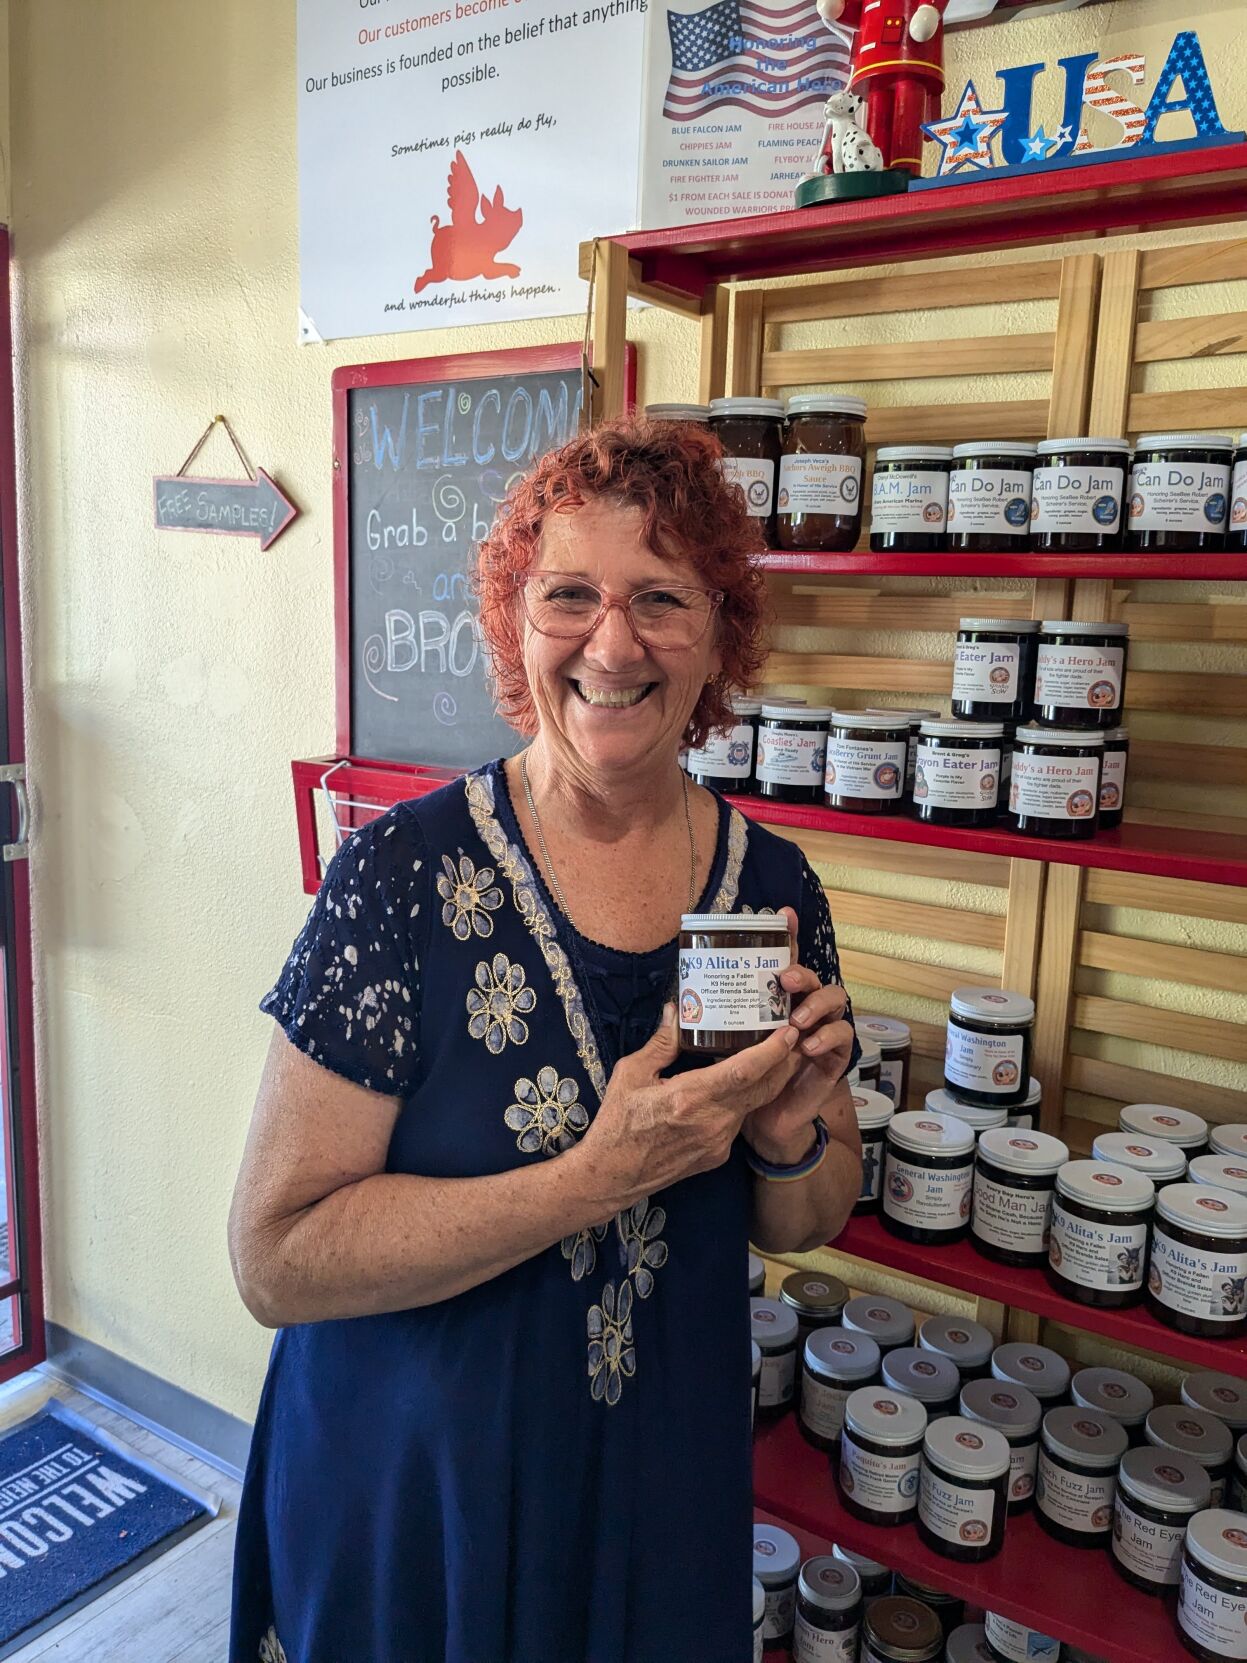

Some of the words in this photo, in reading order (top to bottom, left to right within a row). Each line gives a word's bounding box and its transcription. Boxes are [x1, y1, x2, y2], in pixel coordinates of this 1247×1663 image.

[358, 29, 381, 45] Our
[385, 10, 451, 38] customers
[305, 77, 328, 93] Our
[330, 65, 382, 88] business
[386, 59, 395, 73] is
[399, 45, 454, 70] founded
[458, 43, 474, 57] on
[478, 36, 500, 51] the
[504, 23, 547, 46] belief
[548, 13, 578, 34] that
[582, 0, 648, 25] anything
[729, 35, 816, 50] Honoring
[755, 59, 787, 72] the
[441, 63, 500, 92] possible.
[700, 79, 790, 96] American
[797, 77, 842, 91] Hero
[996, 31, 1227, 165] USA
[692, 125, 724, 133] FALCON
[725, 124, 741, 132] JAM
[768, 123, 785, 131] FIRE
[786, 122, 814, 130] HOUSE
[815, 121, 825, 130] JA
[391, 138, 450, 157] Sometimes
[453, 130, 476, 148] pigs
[480, 122, 513, 140] really
[517, 118, 532, 130] do
[535, 113, 557, 130] fly,
[680, 142, 713, 150] CHIPPIES
[758, 139, 794, 148] FLAMING
[663, 159, 700, 167] DRUNKEN
[702, 158, 729, 166] SAILOR
[731, 157, 748, 165] JAM
[774, 155, 804, 164] FLYBOY
[670, 175, 686, 183] FIRE
[688, 174, 723, 183] FIGHTER
[724, 174, 739, 182] JAM
[669, 193, 679, 201] $1
[681, 192, 706, 201] FROM
[708, 192, 729, 200] EACH
[731, 191, 751, 199] SALE
[754, 191, 761, 199] IS
[685, 206, 730, 215] WOUNDED
[732, 205, 778, 214] WARRIORS
[384, 301, 406, 313] and
[409, 293, 467, 311] wonderful
[469, 288, 506, 301] things
[510, 285, 561, 299] happen.
[808, 464, 837, 473] Aweigh
[839, 465, 856, 474] BBQ
[803, 475, 827, 483] Sauce
[951, 480, 966, 492] Can
[972, 478, 994, 492] Do
[998, 478, 1024, 496] Jam
[1035, 478, 1051, 491] Can
[1058, 475, 1081, 489] Do
[1086, 475, 1113, 493] Jam
[1137, 472, 1160, 486] Can
[1168, 471, 1194, 486] Do
[1198, 472, 1223, 490] Jam
[907, 481, 931, 497] Jam
[158, 489, 191, 523] FREE
[367, 508, 427, 550] Grab
[442, 521, 456, 543] a
[385, 609, 490, 676] BRO
[960, 651, 987, 661] Eater
[989, 652, 1014, 664] Jam
[1068, 657, 1094, 666] Hero
[1096, 658, 1116, 667] Jam
[797, 739, 816, 747] Jam
[857, 752, 881, 760] Grunt
[917, 758, 939, 768] rayon
[943, 759, 977, 769] Eater
[979, 760, 998, 771] Jam
[1014, 762, 1034, 773] addy's
[1046, 765, 1072, 776] Hero
[1075, 767, 1093, 776] Jam
[1104, 761, 1120, 769] Jam
[688, 957, 702, 969] K9
[706, 957, 751, 969] Alita's
[755, 956, 779, 969] Jam
[961, 1032, 1006, 1048] Washington
[960, 1045, 974, 1055] Jam
[896, 1164, 925, 1180] General
[926, 1185, 943, 1193] Jam
[999, 1196, 1026, 1211] Man
[1067, 1222, 1103, 1241] Alita's
[1107, 1233, 1132, 1243] Jam
[1156, 1239, 1166, 1254] K9
[1168, 1249, 1207, 1270] Alita's
[1210, 1262, 1237, 1273] Jam
[62, 1448, 93, 1466] TO
[38, 1461, 71, 1485] THE
[1061, 1476, 1083, 1492] Fuzz
[1086, 1484, 1105, 1495] Jam
[932, 1482, 952, 1500] Fuzz
[954, 1494, 974, 1506] Jam
[1134, 1519, 1156, 1536] Red
[1159, 1529, 1181, 1542] Eye
[1131, 1533, 1153, 1550] Jam
[1196, 1583, 1217, 1604] Red
[1222, 1597, 1246, 1612] Eye
[1192, 1599, 1214, 1618] Jam
